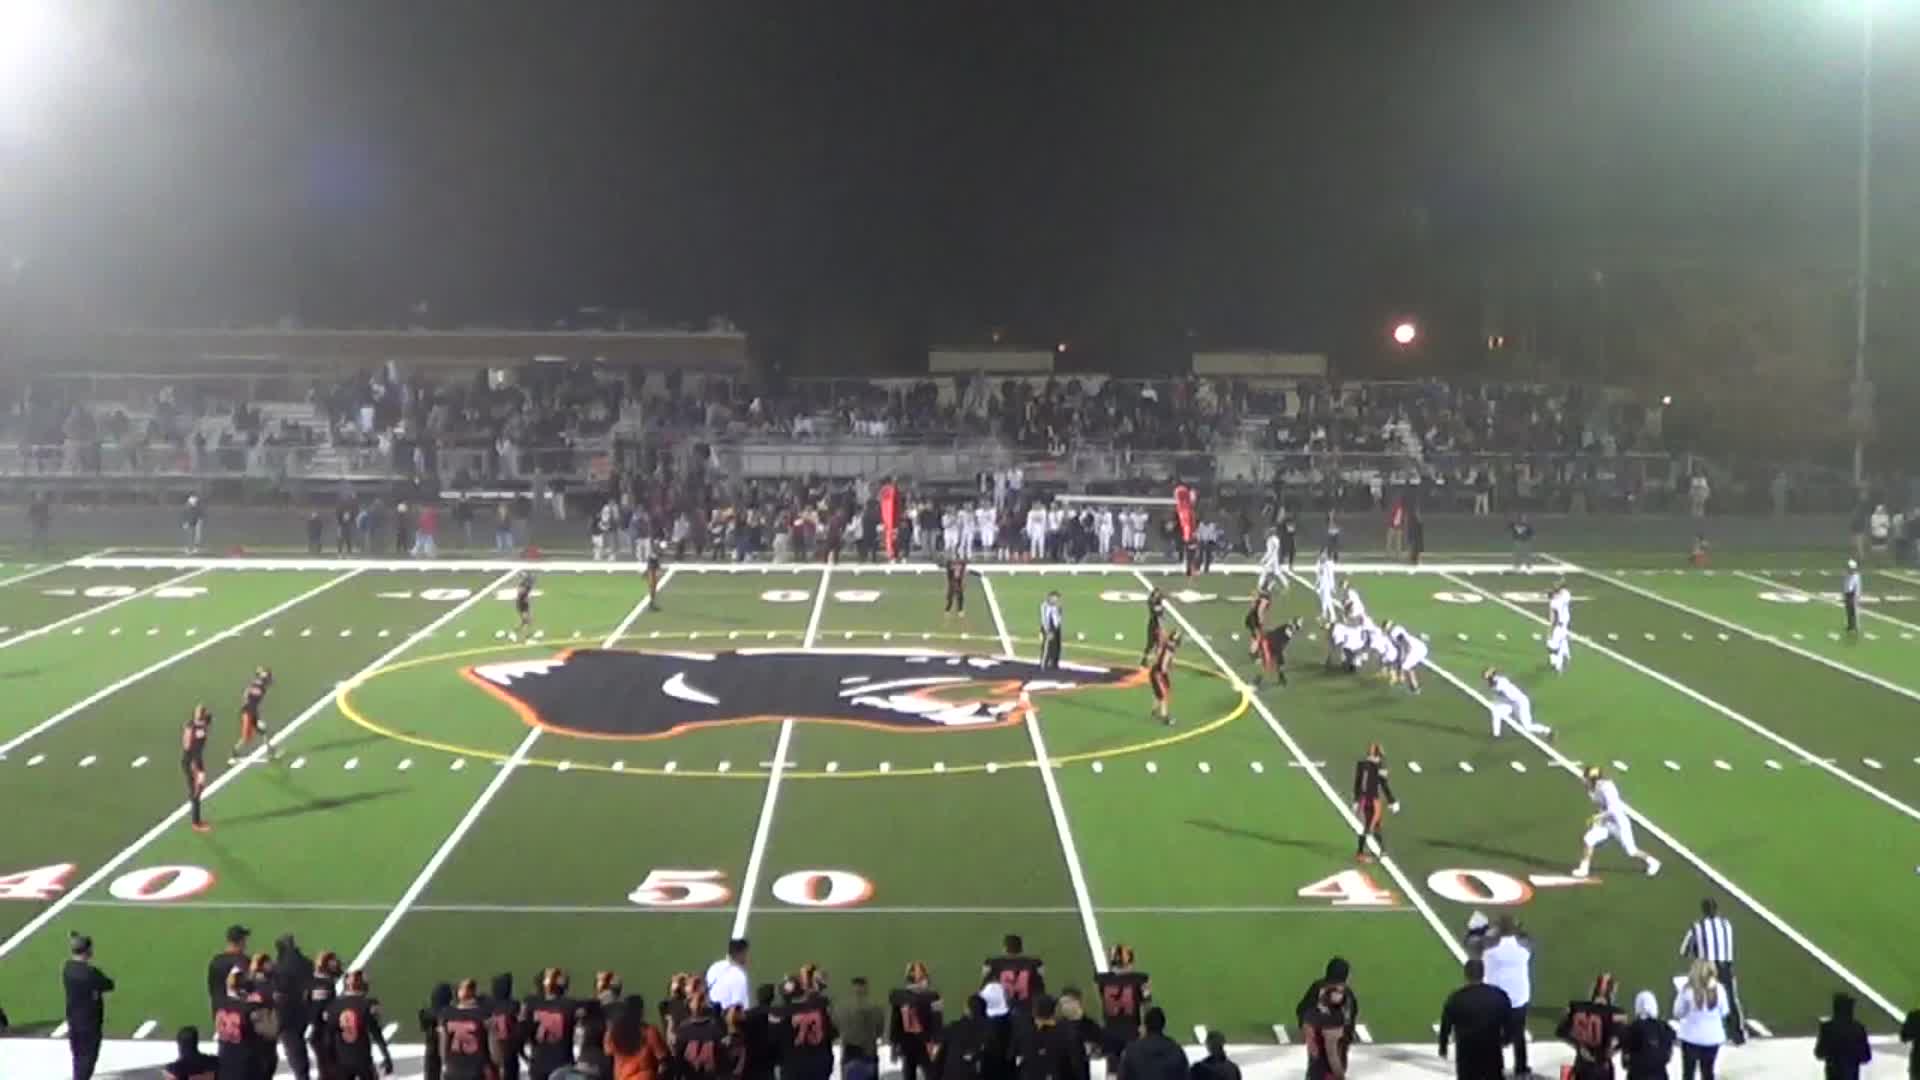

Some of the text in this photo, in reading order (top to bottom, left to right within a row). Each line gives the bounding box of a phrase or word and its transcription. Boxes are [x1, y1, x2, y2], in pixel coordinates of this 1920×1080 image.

[627, 870, 875, 907] 50
[1297, 869, 1535, 906] 40
[447, 1019, 480, 1053] 75
